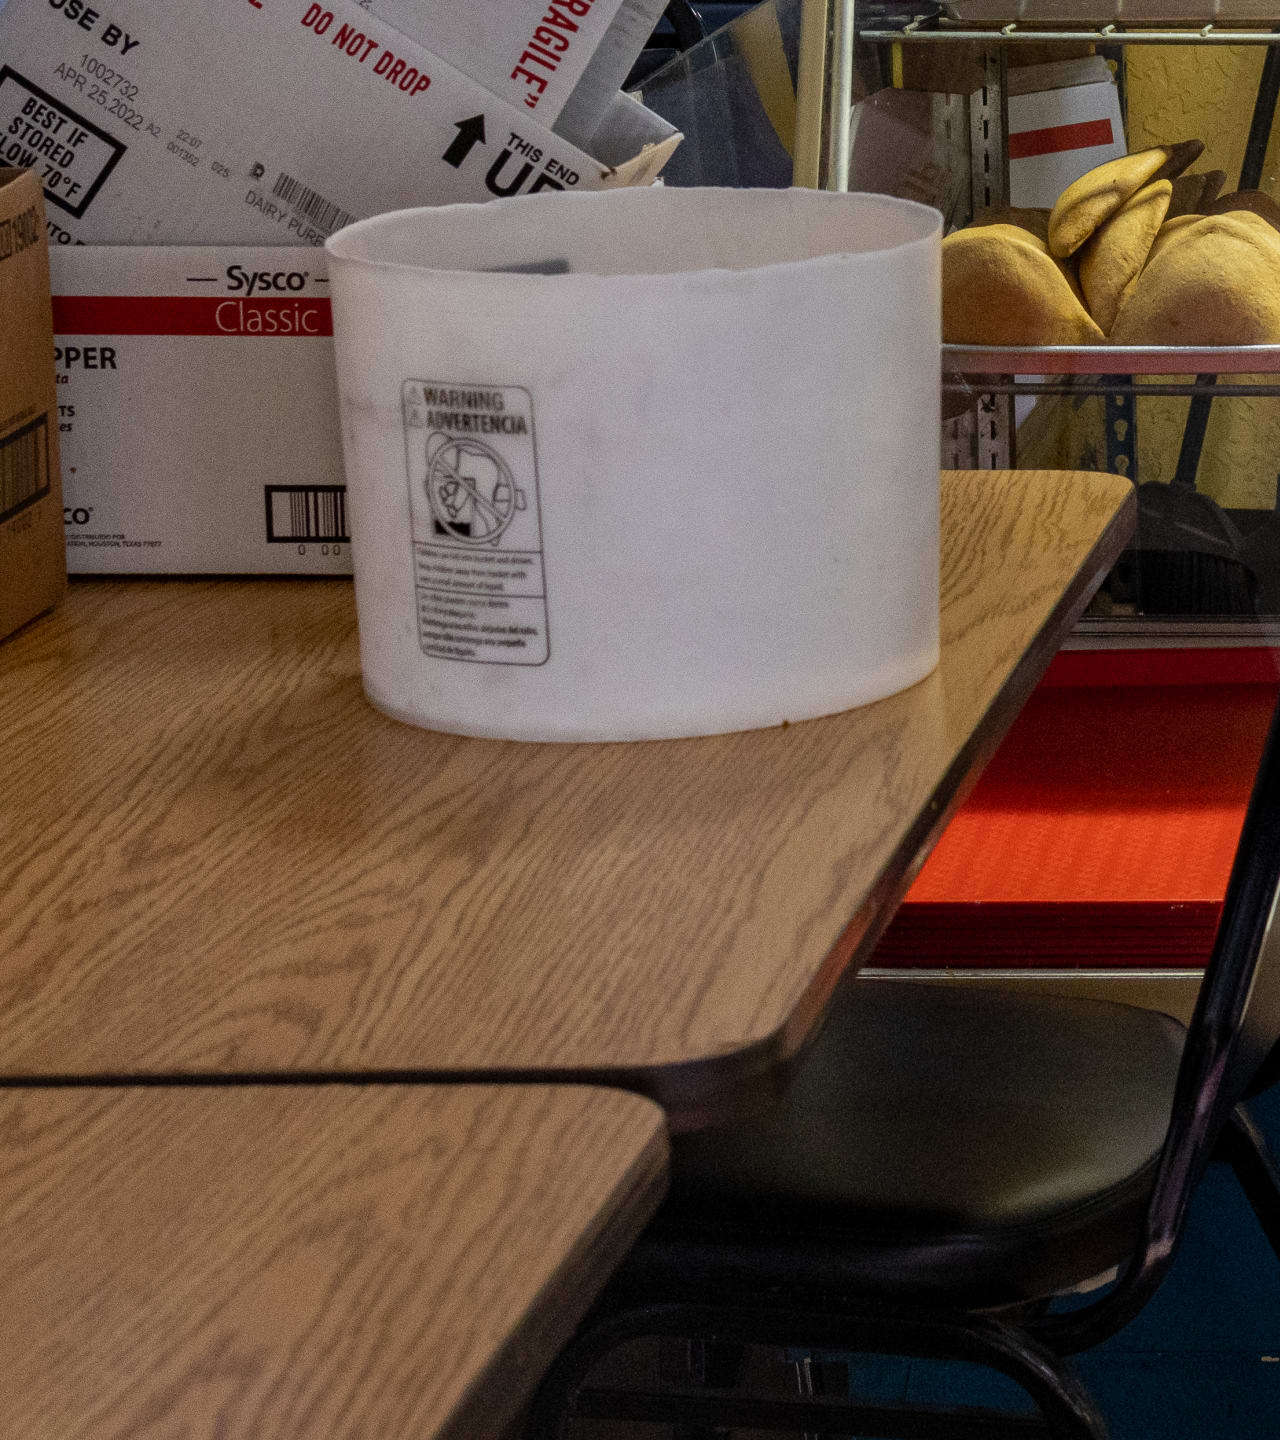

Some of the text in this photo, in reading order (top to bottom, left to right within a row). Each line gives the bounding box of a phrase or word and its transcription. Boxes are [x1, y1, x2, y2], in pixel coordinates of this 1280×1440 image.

[100, 23, 140, 56] BY
[301, 2, 334, 36] DO
[332, 23, 379, 64] NOT
[372, 51, 431, 96] DROP
[53, 62, 87, 92] APR
[81, 53, 139, 102] 1002732
[21, 96, 89, 148] BEST IF
[8, 116, 75, 169] STORED
[507, 132, 580, 186] THIS END
[41, 163, 82, 198] 70°F
[244, 190, 287, 223] DAIRY
[226, 265, 306, 296] Sysco
[215, 300, 319, 333] Classic
[423, 387, 504, 411] WARNING
[427, 410, 528, 435] ADVERTENCIA
